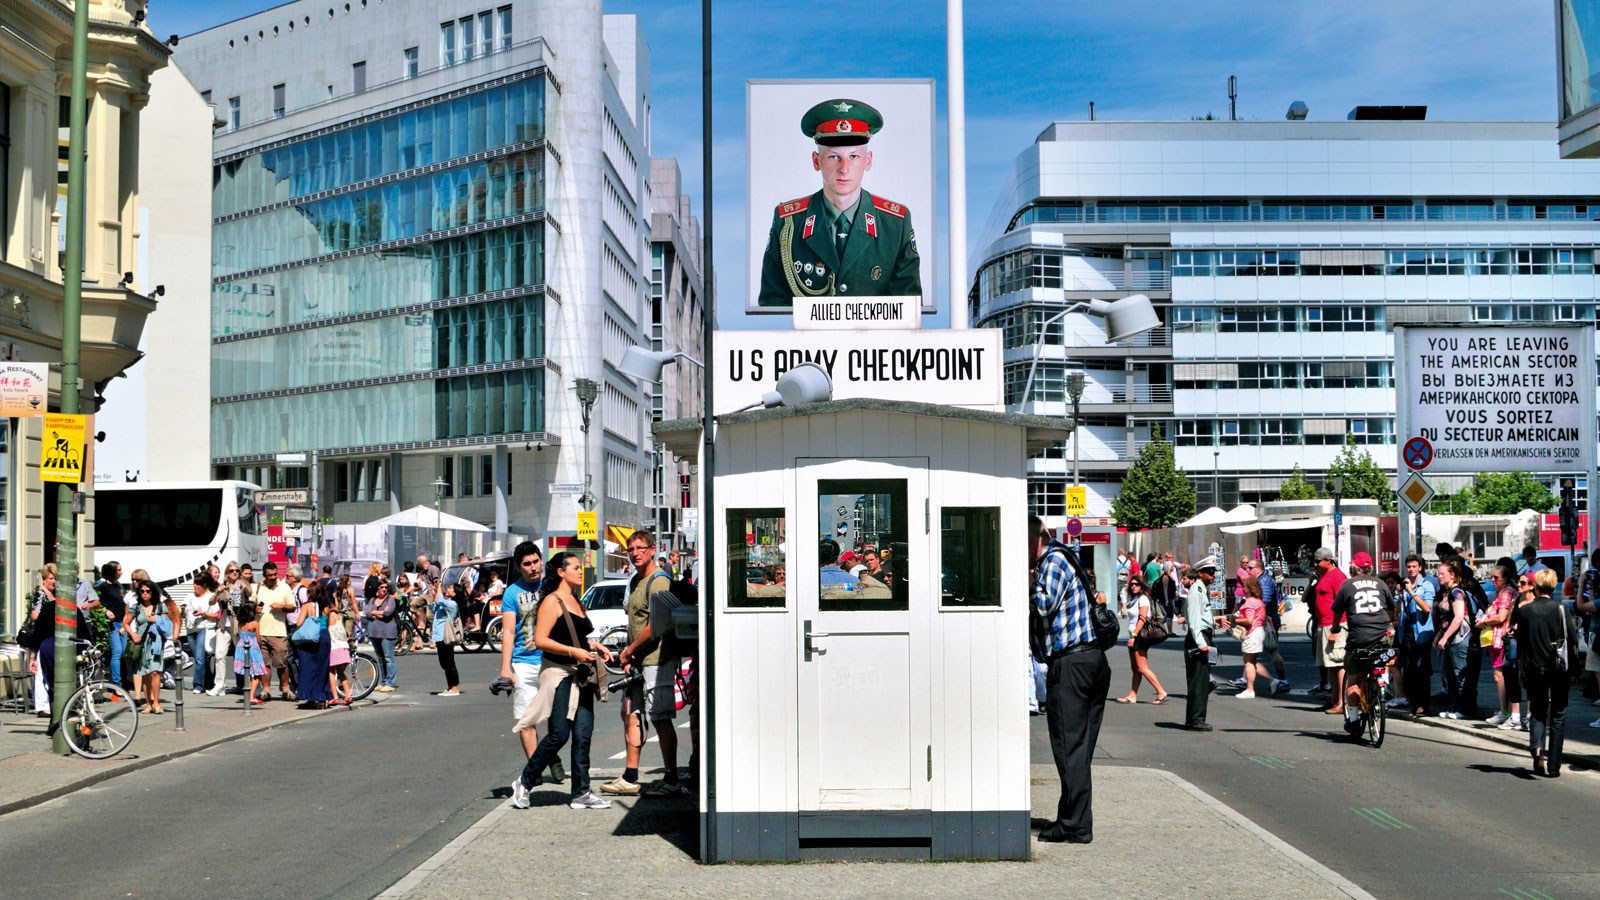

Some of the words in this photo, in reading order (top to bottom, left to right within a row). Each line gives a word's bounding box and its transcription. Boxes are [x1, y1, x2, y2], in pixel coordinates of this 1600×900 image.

[811, 303, 841, 321] ALLIED
[846, 302, 904, 320] CHECKPOINT
[1428, 338, 1458, 351] YOU
[1468, 338, 1497, 351] ARE
[1507, 337, 1569, 351] LEAVING
[849, 348, 985, 382] CHECKPOINT
[1420, 355, 1444, 369] THE
[1451, 355, 1520, 369] AMERICAN
[1528, 355, 1578, 369] SECTOR
[7, 366, 43, 383] RESTAURANT
[1555, 374, 1574, 387] ИЗ
[1419, 391, 1521, 405] АМЕРИКАНСКОГО
[1527, 391, 1580, 405] СЕКТОРА
[1446, 410, 1488, 424] VOUS
[1496, 410, 1553, 424] SORTEZ
[1420, 428, 1438, 441] DU
[1444, 427, 1504, 441] SECTEUR
[1507, 425, 1579, 441] AMÉRICAIN
[1433, 448, 1473, 458] VERLASSEN
[1475, 448, 1489, 458] DEN
[1491, 448, 1551, 458] AMERIKANISCHEN
[1554, 448, 1580, 458] SEKTOR
[260, 491, 303, 501] Zimmerstraße
[1352, 579, 1379, 590] THOME
[1354, 589, 1381, 614] 25
